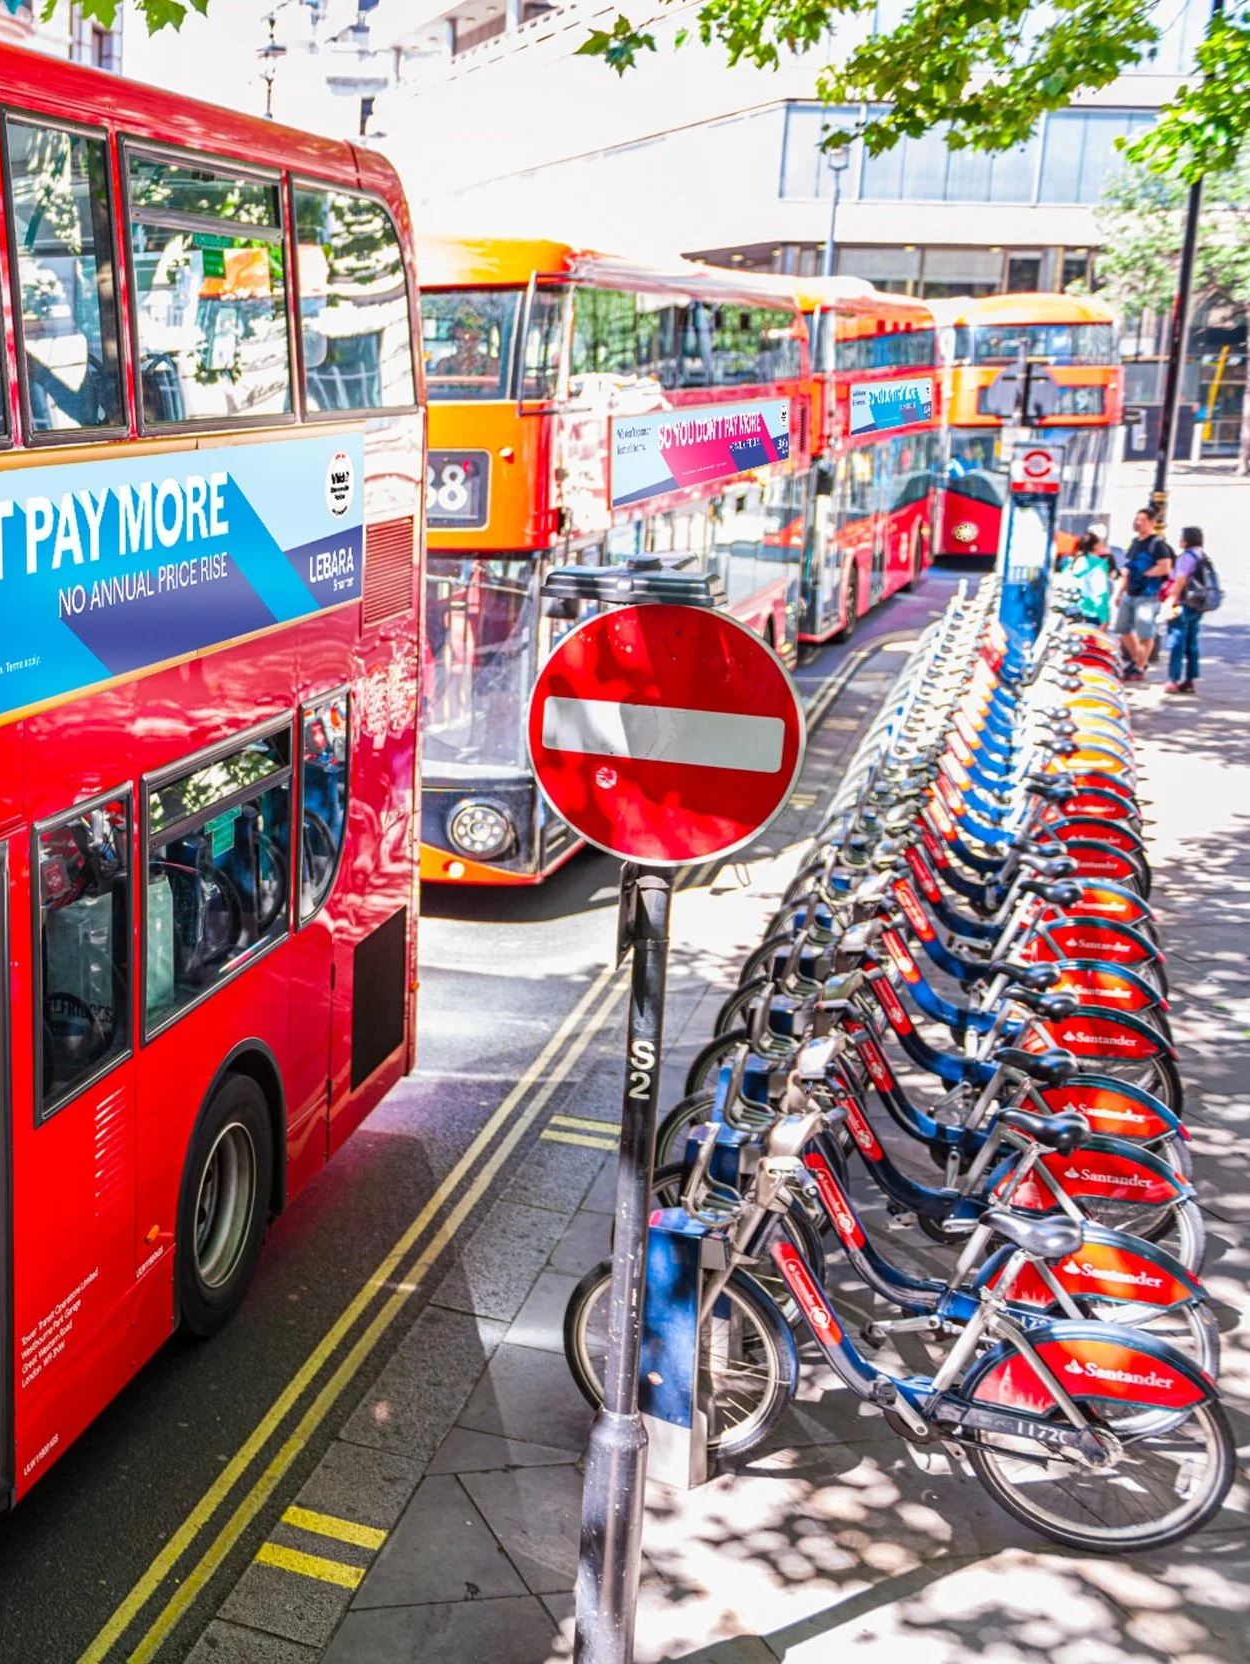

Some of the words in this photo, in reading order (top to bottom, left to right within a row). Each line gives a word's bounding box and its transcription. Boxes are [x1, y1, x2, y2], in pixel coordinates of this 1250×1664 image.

[658, 424, 672, 450] SO
[673, 419, 694, 447] YOU
[26, 487, 110, 575] PAY
[119, 471, 229, 556] MORE
[309, 547, 354, 583] LEBARA
[59, 585, 86, 618] NO
[90, 569, 154, 610] ANNUAL
[158, 558, 198, 593] PRICE
[200, 552, 228, 582] RISE
[1078, 938, 1131, 952] Santander
[1076, 984, 1132, 998] Santander
[1076, 1031, 1137, 1047] Santander
[1078, 1103, 1146, 1123] Santander
[1080, 1168, 1154, 1188] Santander
[1082, 1263, 1163, 1288] Santander
[21, 1328, 37, 1346] Tower
[54, 1285, 81, 1315] Operations
[21, 1326, 54, 1360] Westbourne
[53, 1315, 64, 1332] Park
[64, 1299, 81, 1320] Garage
[22, 1355, 37, 1375] Great
[38, 1336, 60, 1359] Western
[59, 1319, 72, 1338] Road
[21, 1364, 42, 1389] London
[1085, 1362, 1174, 1389] Santander
